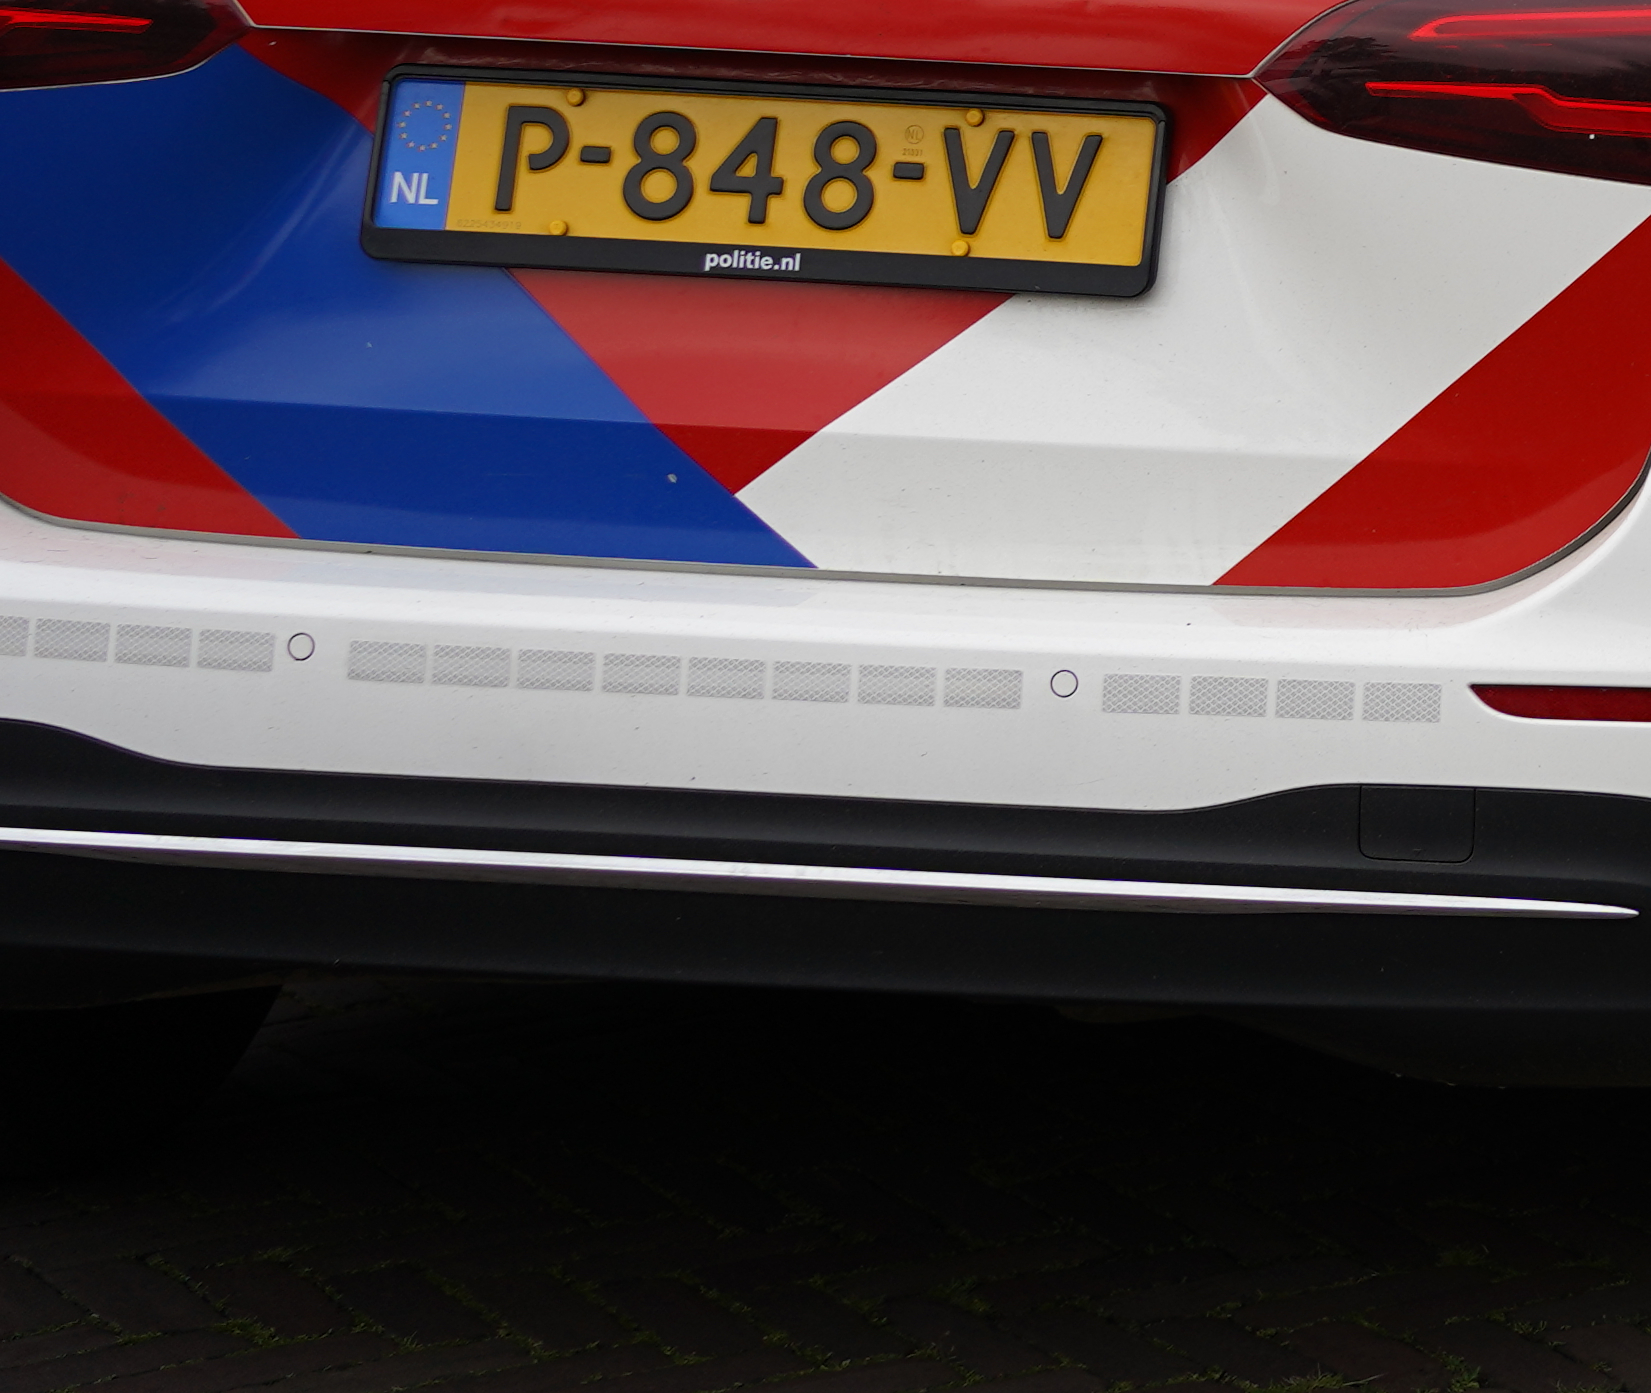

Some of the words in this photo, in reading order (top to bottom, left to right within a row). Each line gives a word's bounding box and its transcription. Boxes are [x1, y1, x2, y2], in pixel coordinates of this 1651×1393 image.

[391, 170, 439, 206] NL
[493, 104, 1104, 240] P-848-VV
[703, 247, 801, 274] politie.nl
